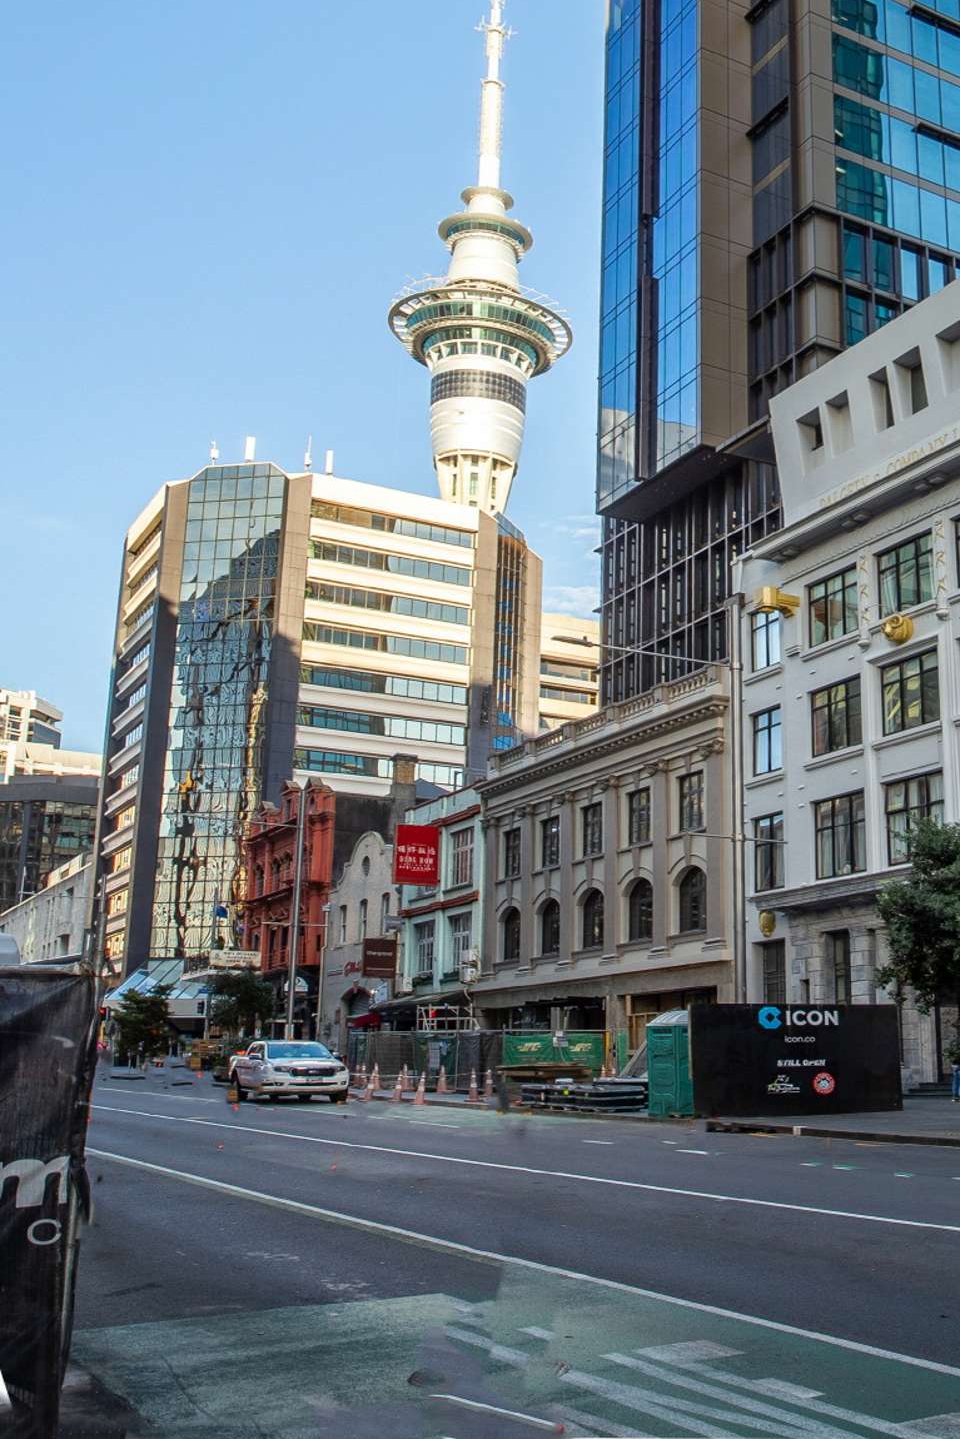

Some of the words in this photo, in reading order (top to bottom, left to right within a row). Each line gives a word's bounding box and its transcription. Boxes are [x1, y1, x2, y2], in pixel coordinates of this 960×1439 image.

[785, 1010, 839, 1026] ICON
[784, 1035, 816, 1043] icon.co
[776, 1059, 801, 1067] STILL
[802, 1059, 826, 1067] OPEN
